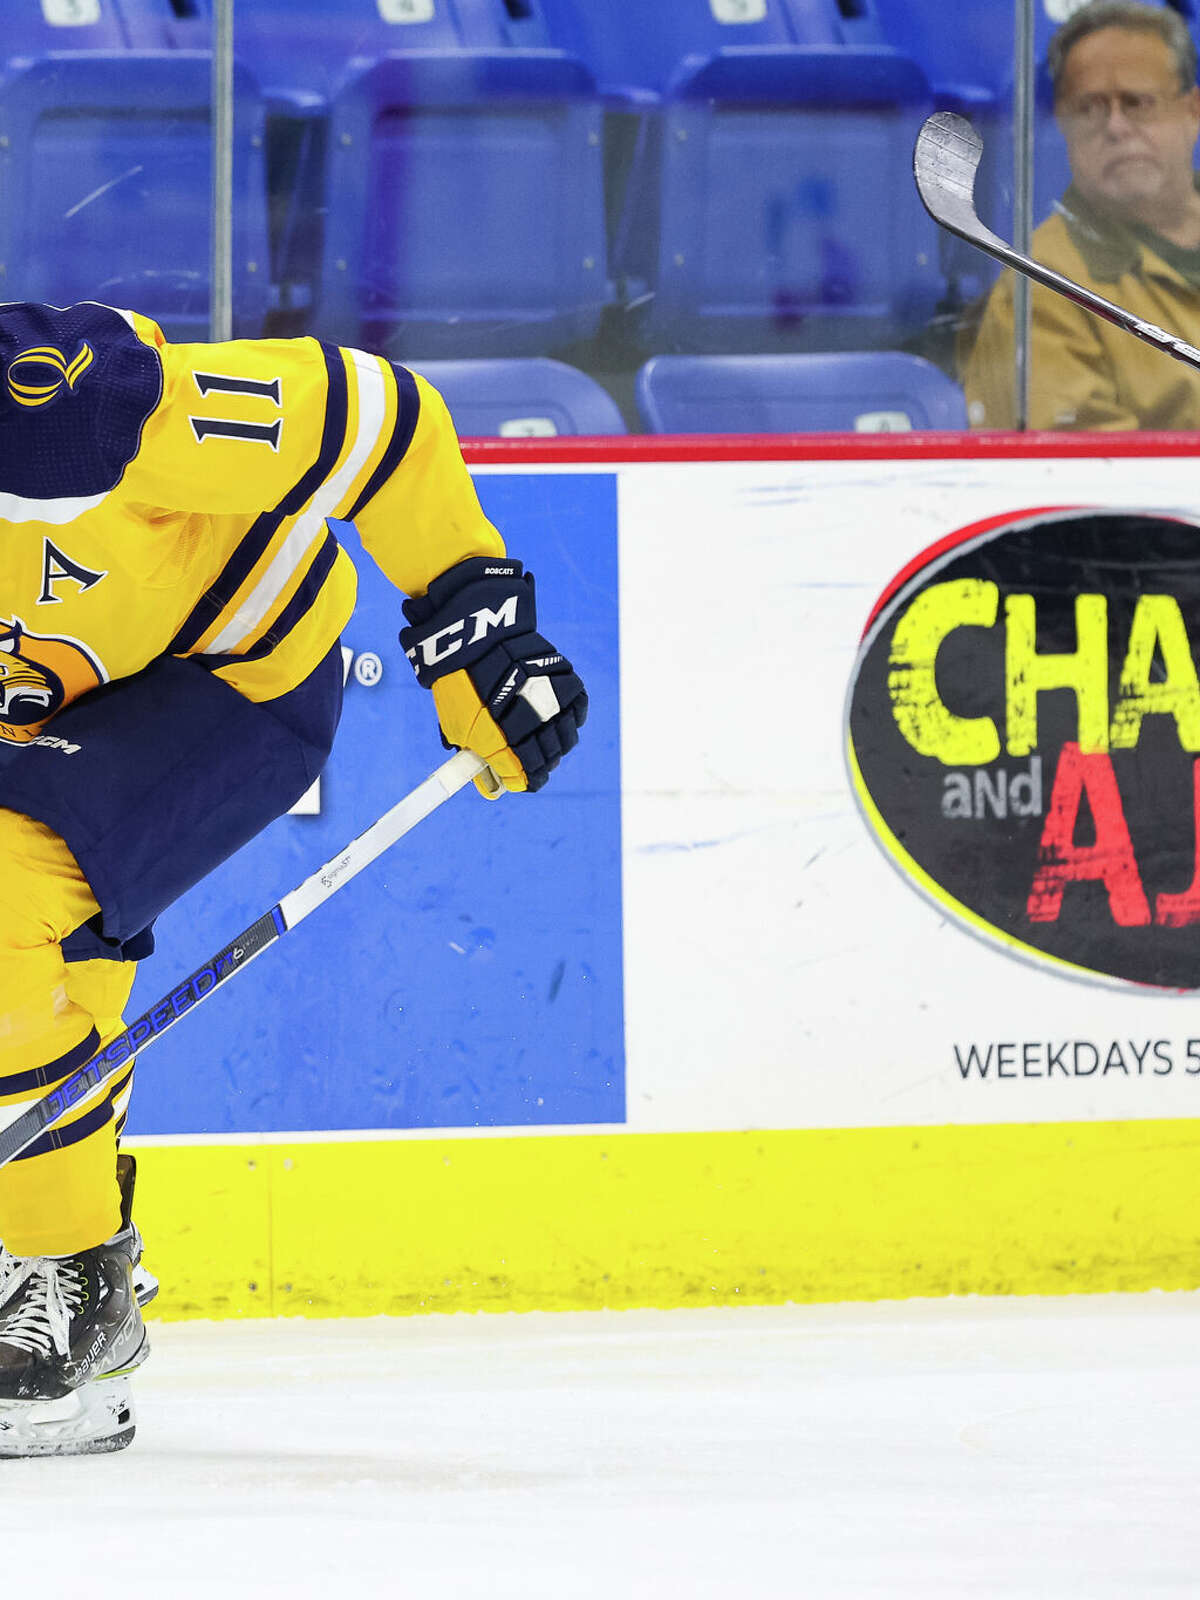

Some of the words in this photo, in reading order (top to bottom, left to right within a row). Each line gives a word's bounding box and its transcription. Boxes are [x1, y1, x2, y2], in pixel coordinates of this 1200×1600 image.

[188, 370, 284, 453] 11
[35, 535, 109, 606] A
[484, 567, 514, 576] BOBCATS
[44, 968, 217, 1125] JETSPEED
[953, 1040, 1173, 1079] WEEKDAYS
